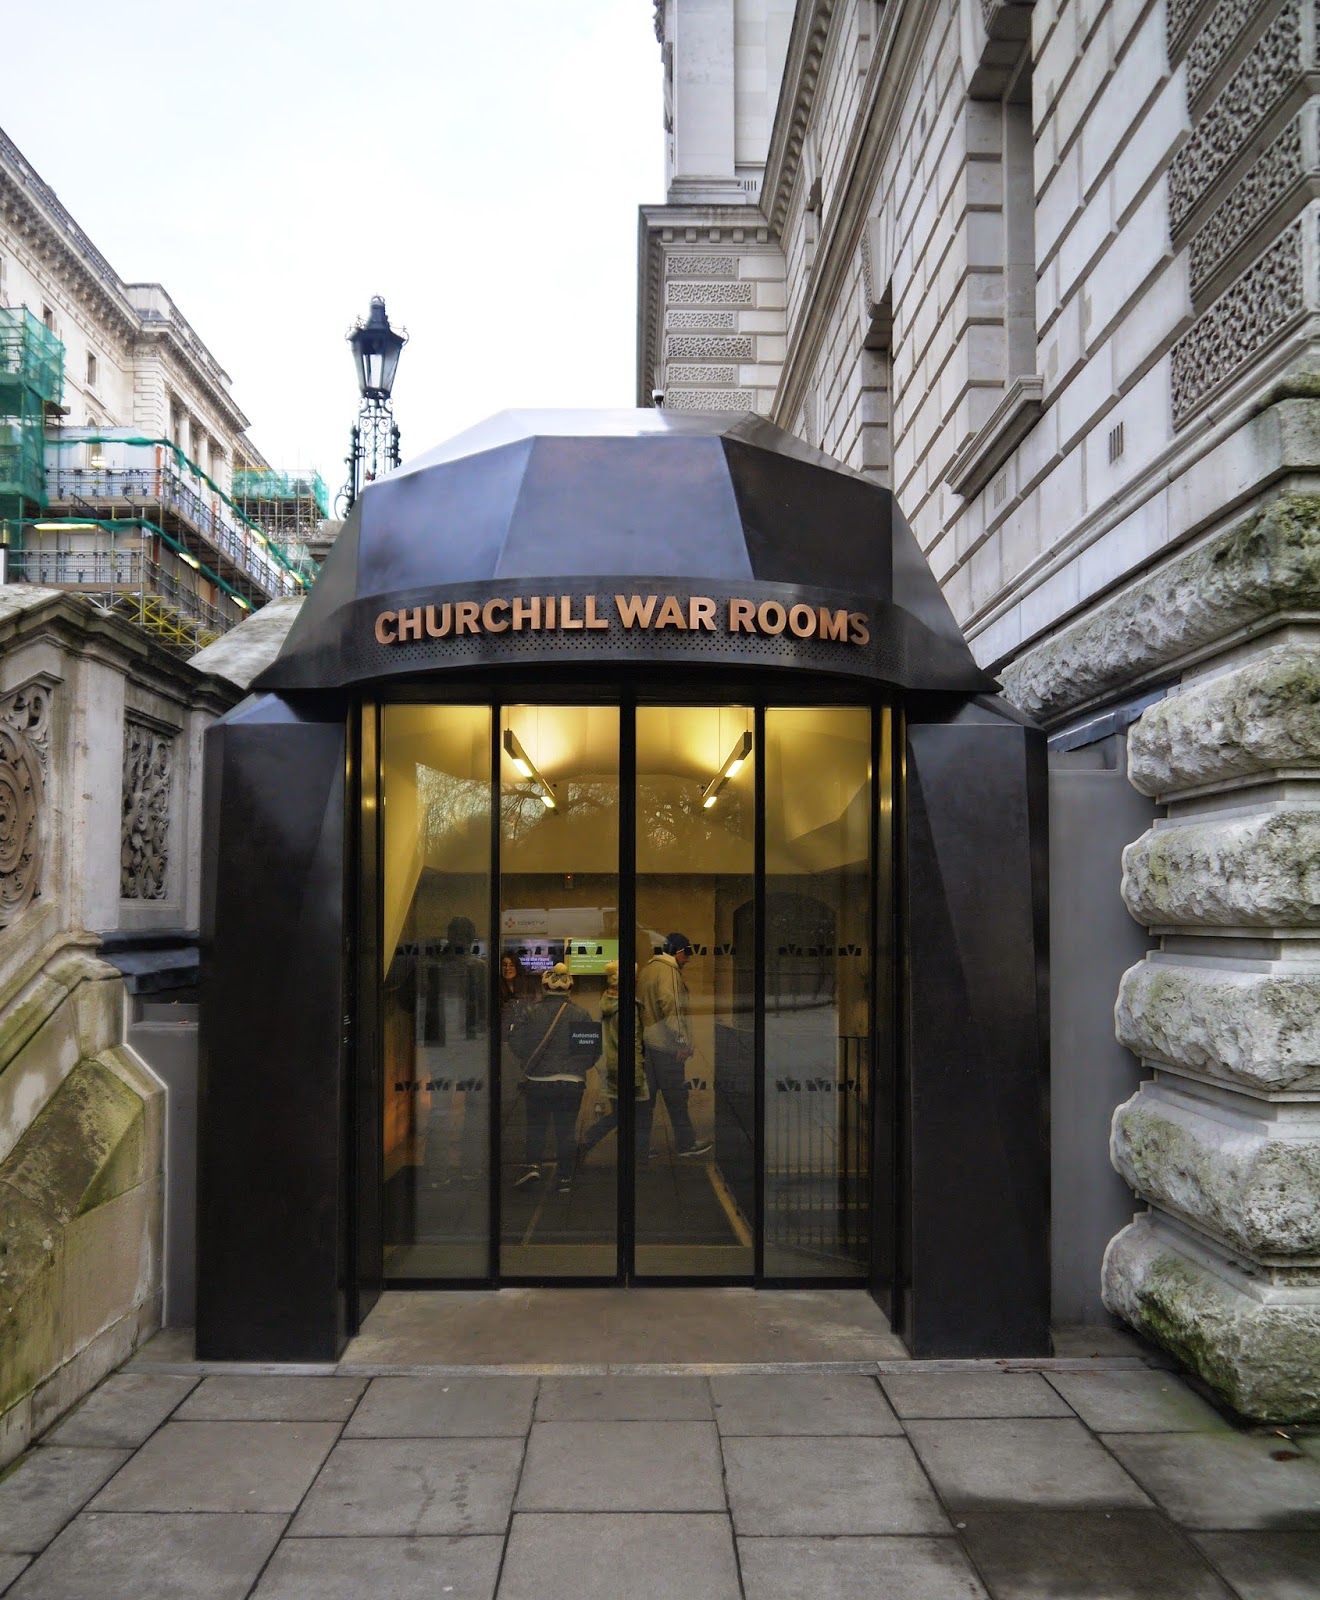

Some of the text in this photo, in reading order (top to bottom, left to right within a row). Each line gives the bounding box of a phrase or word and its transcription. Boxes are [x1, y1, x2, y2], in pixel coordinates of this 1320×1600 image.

[375, 595, 870, 646] CHURCHILL WAR ROOMS
